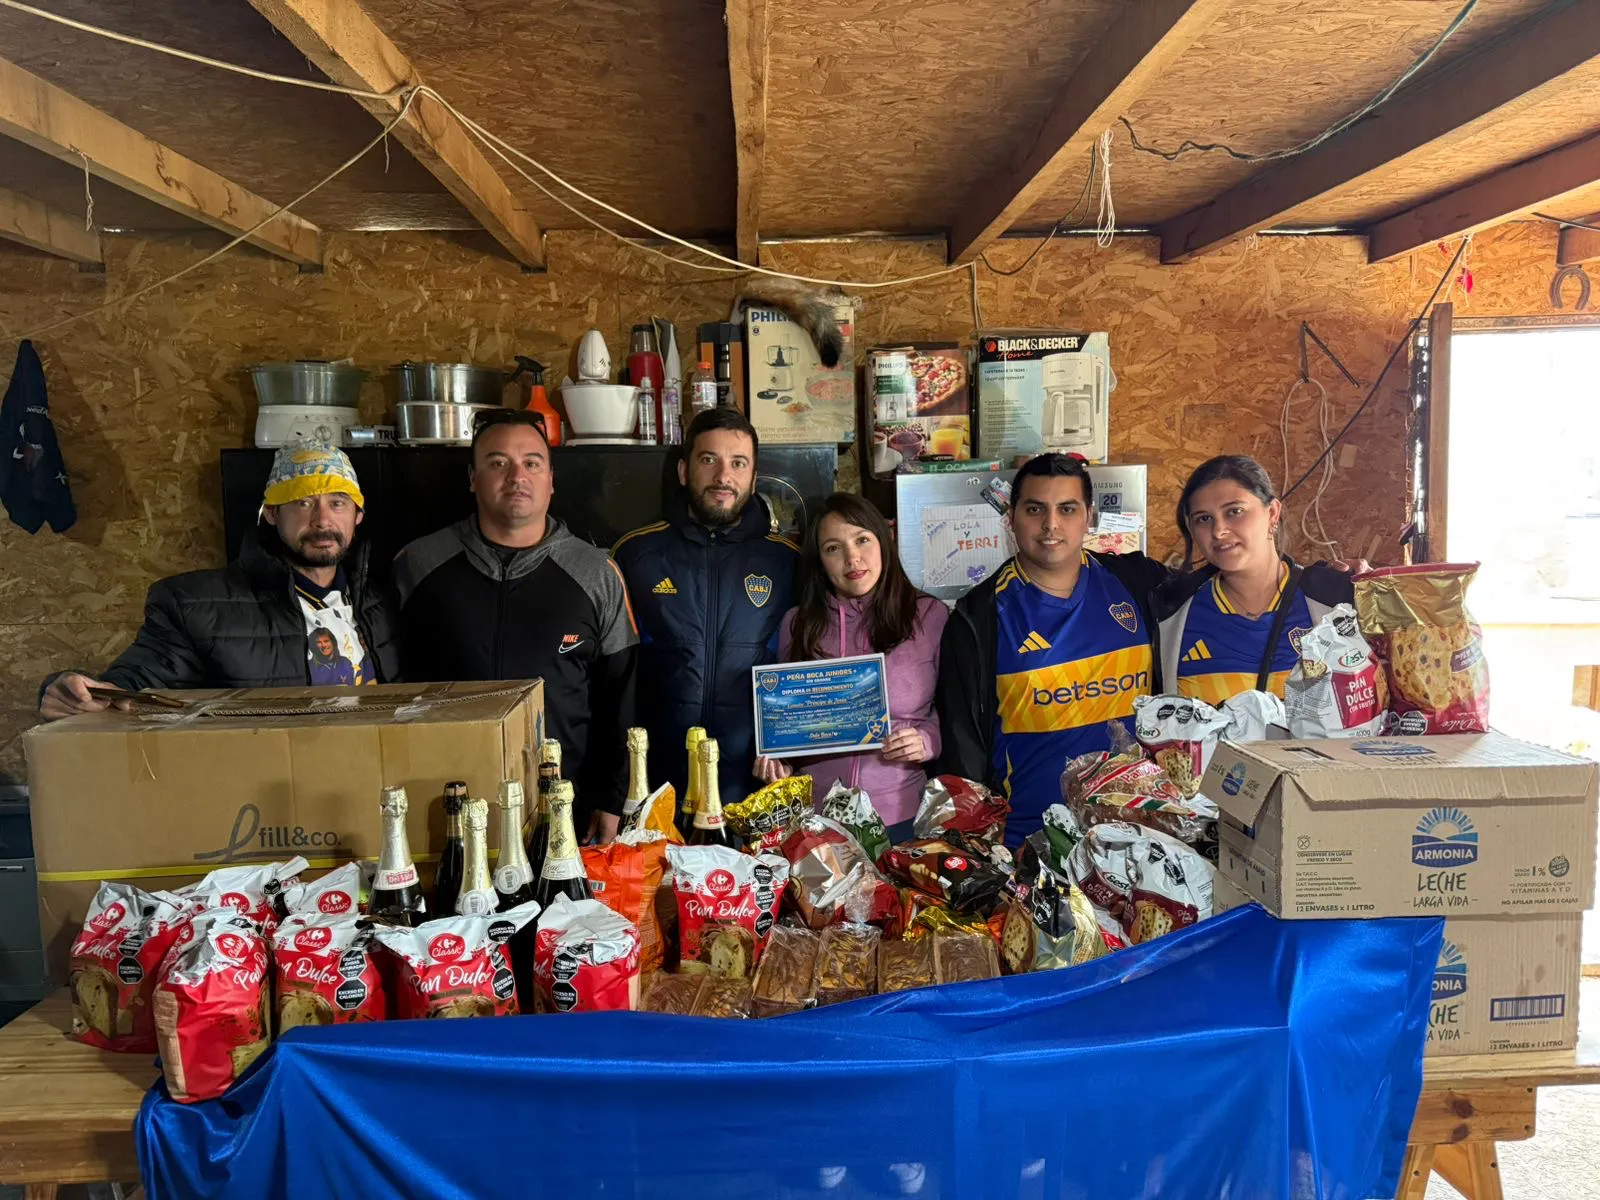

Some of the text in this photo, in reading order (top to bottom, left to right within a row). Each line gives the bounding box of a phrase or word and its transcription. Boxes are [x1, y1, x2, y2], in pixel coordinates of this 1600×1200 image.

[997, 336, 1078, 352] BLACK&DECKER
[1103, 494, 1118, 506] 20
[953, 520, 980, 531] LOLA
[748, 584, 769, 593] CABJ
[562, 634, 580, 643] NIKE
[786, 668, 853, 681] PEÑA BOCA JUNIORS
[1033, 670, 1148, 706] betsson
[1348, 675, 1367, 691] PAN
[781, 687, 806, 696] DIPLOMA
[1345, 686, 1375, 707] DULCE
[258, 826, 342, 847] fill&co.
[1415, 848, 1475, 860] ARMONIA
[1106, 874, 1130, 890] Best
[1417, 871, 1468, 894] LECHE
[685, 896, 756, 919] Pan Dulce
[1413, 895, 1469, 908] LARGA VIDA
[233, 962, 264, 991] Pan
[296, 957, 338, 985] Dulce
[408, 974, 442, 996] Pan
[1432, 979, 1463, 991] ONIA
[1428, 1003, 1459, 1027] CHE
[1438, 1029, 1461, 1041] VIDA
